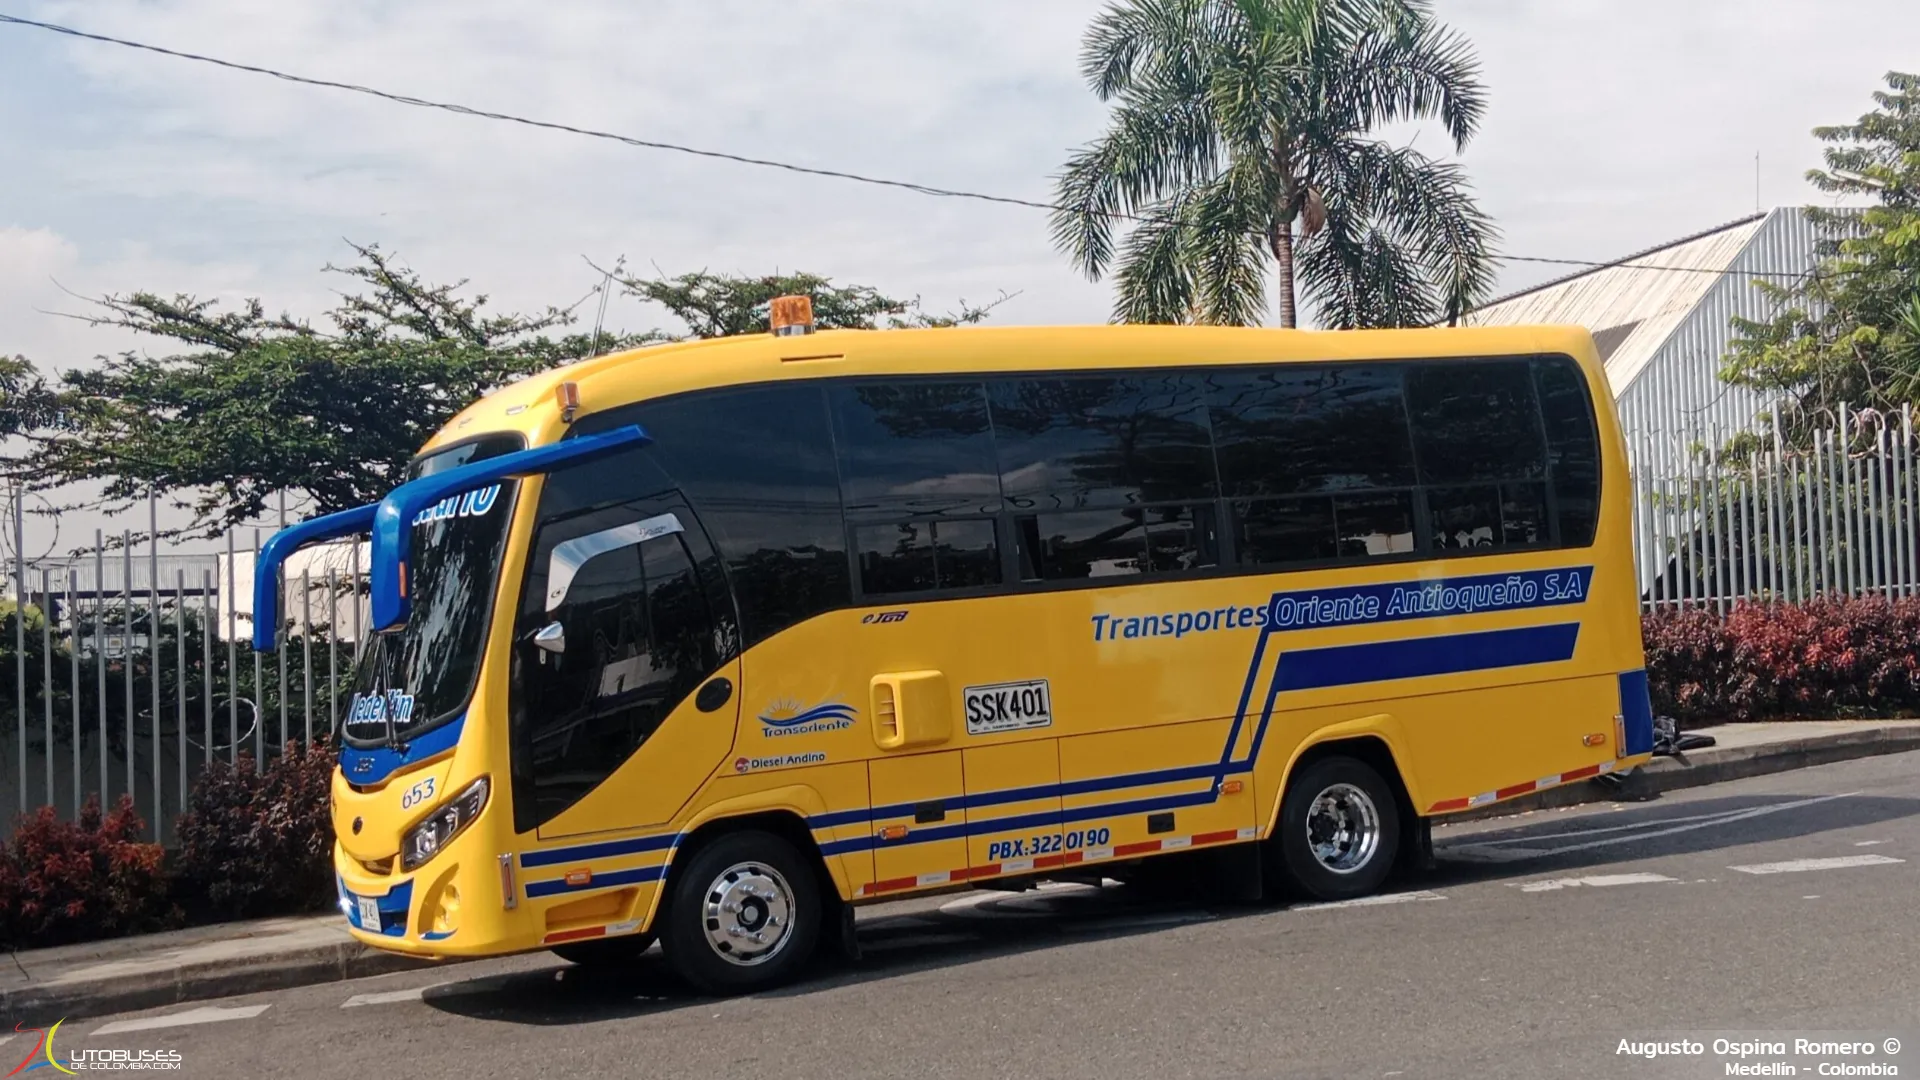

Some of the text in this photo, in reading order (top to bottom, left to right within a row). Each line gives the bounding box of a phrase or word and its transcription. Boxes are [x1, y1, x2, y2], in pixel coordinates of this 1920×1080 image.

[1091, 604, 1269, 641] Transportes
[1275, 593, 1380, 626] Oriente
[1386, 576, 1538, 616] Antioqueño
[967, 687, 1047, 724] SSK401
[762, 720, 850, 738] Transoriente
[751, 753, 826, 769] Diesel Andino
[402, 777, 435, 809] 653
